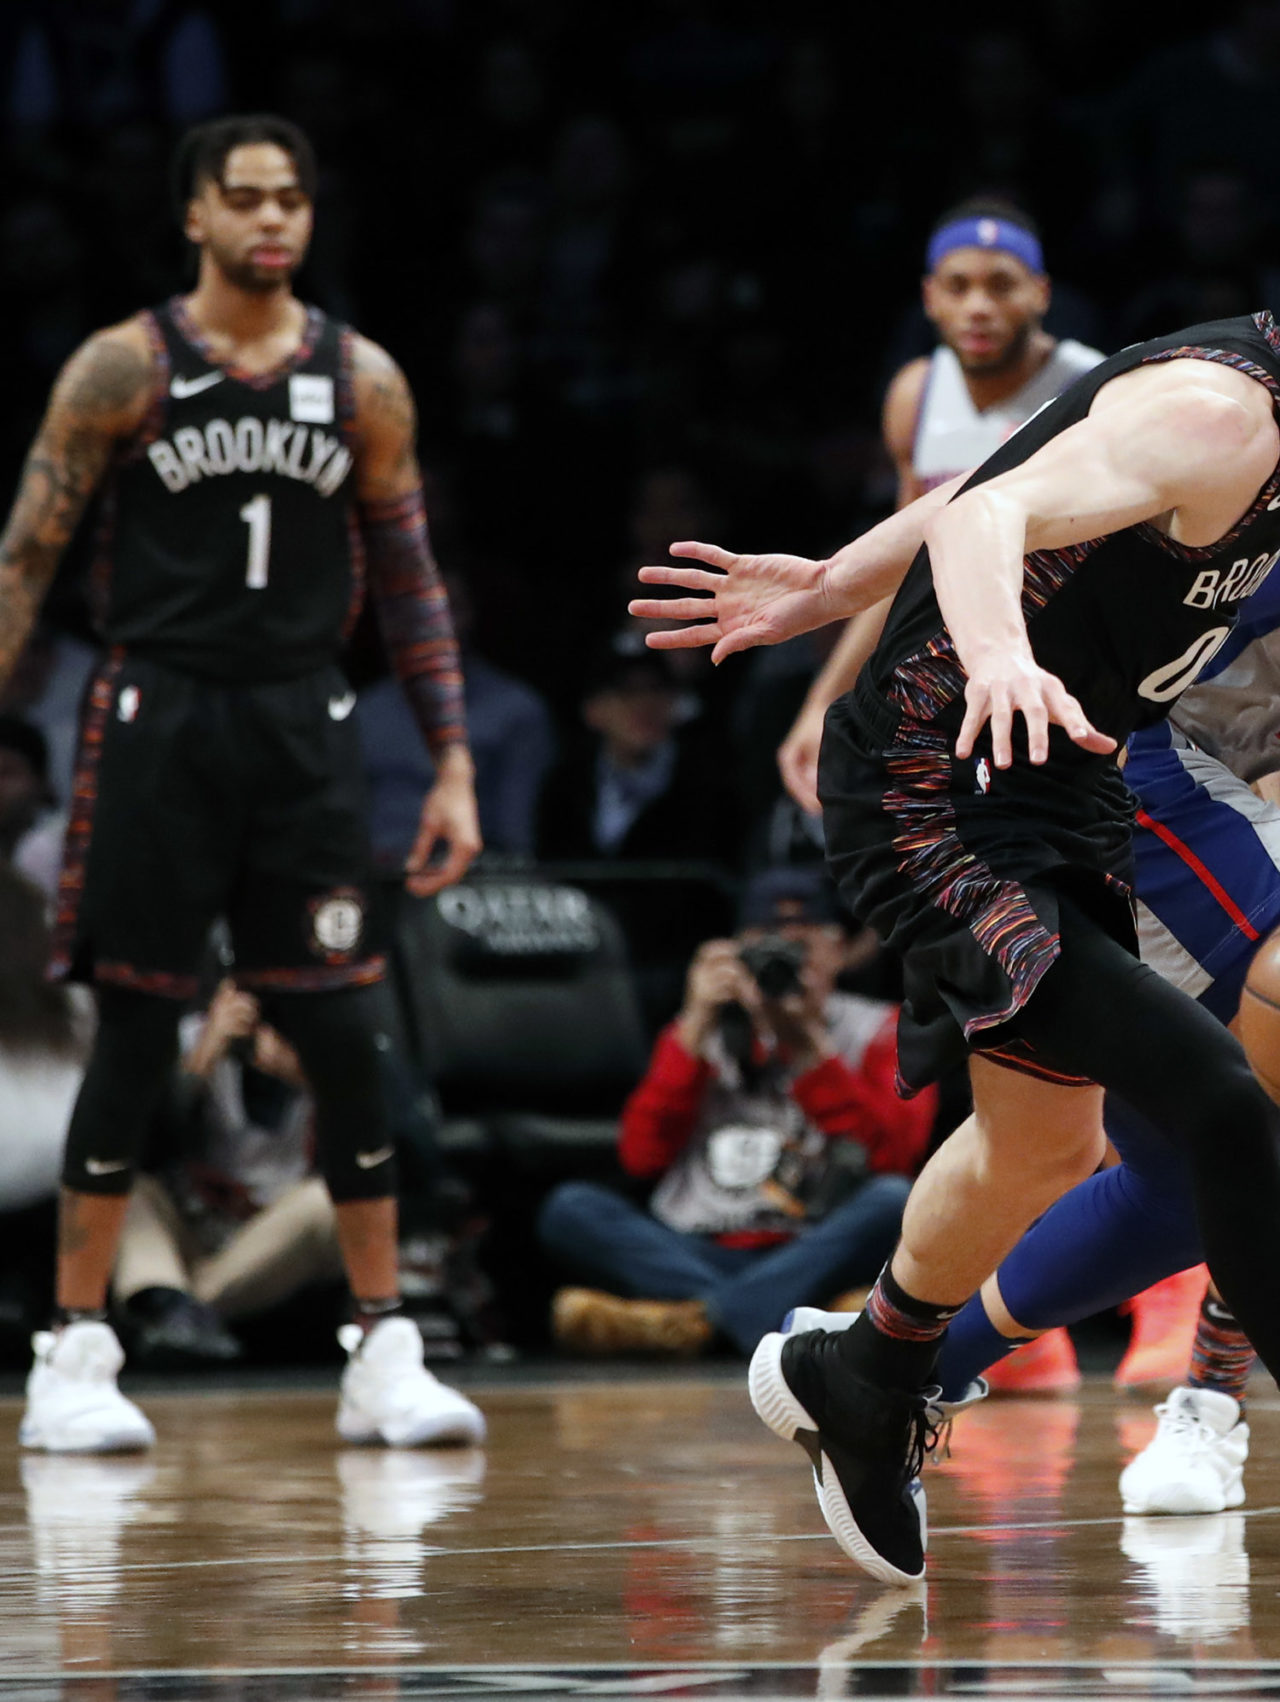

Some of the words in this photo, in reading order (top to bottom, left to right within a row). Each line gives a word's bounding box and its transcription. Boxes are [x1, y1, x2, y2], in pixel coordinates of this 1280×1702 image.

[147, 416, 354, 498] BROOKLYN
[239, 494, 271, 588] 1
[1137, 626, 1229, 703] 0
